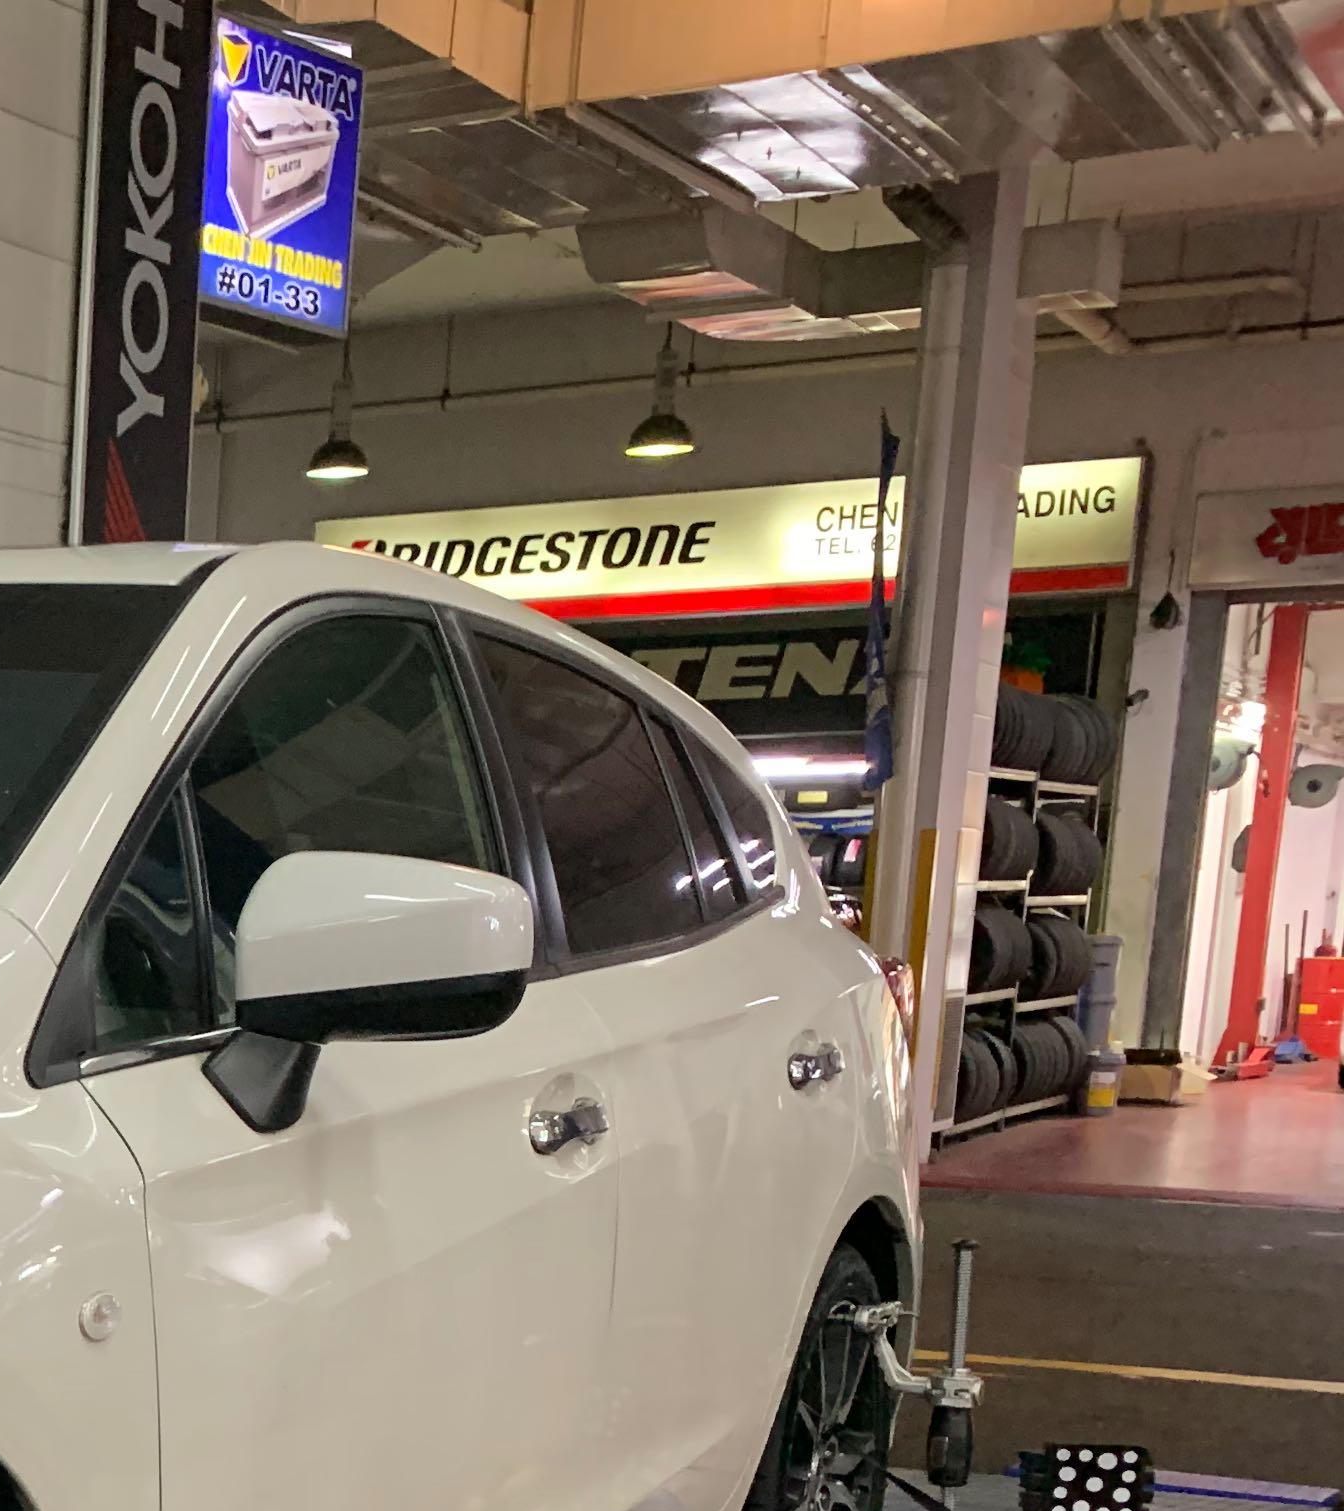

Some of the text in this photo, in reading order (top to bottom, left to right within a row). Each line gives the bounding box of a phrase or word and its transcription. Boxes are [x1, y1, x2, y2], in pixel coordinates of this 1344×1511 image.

[256, 46, 354, 120] VARTA
[115, 0, 185, 438] YOKOH
[218, 265, 321, 317] #01-33
[274, 243, 343, 290] TRADING
[815, 485, 1116, 533] CHEN ADING
[815, 532, 898, 556] TEL. 62
[630, 638, 868, 700] TEN
